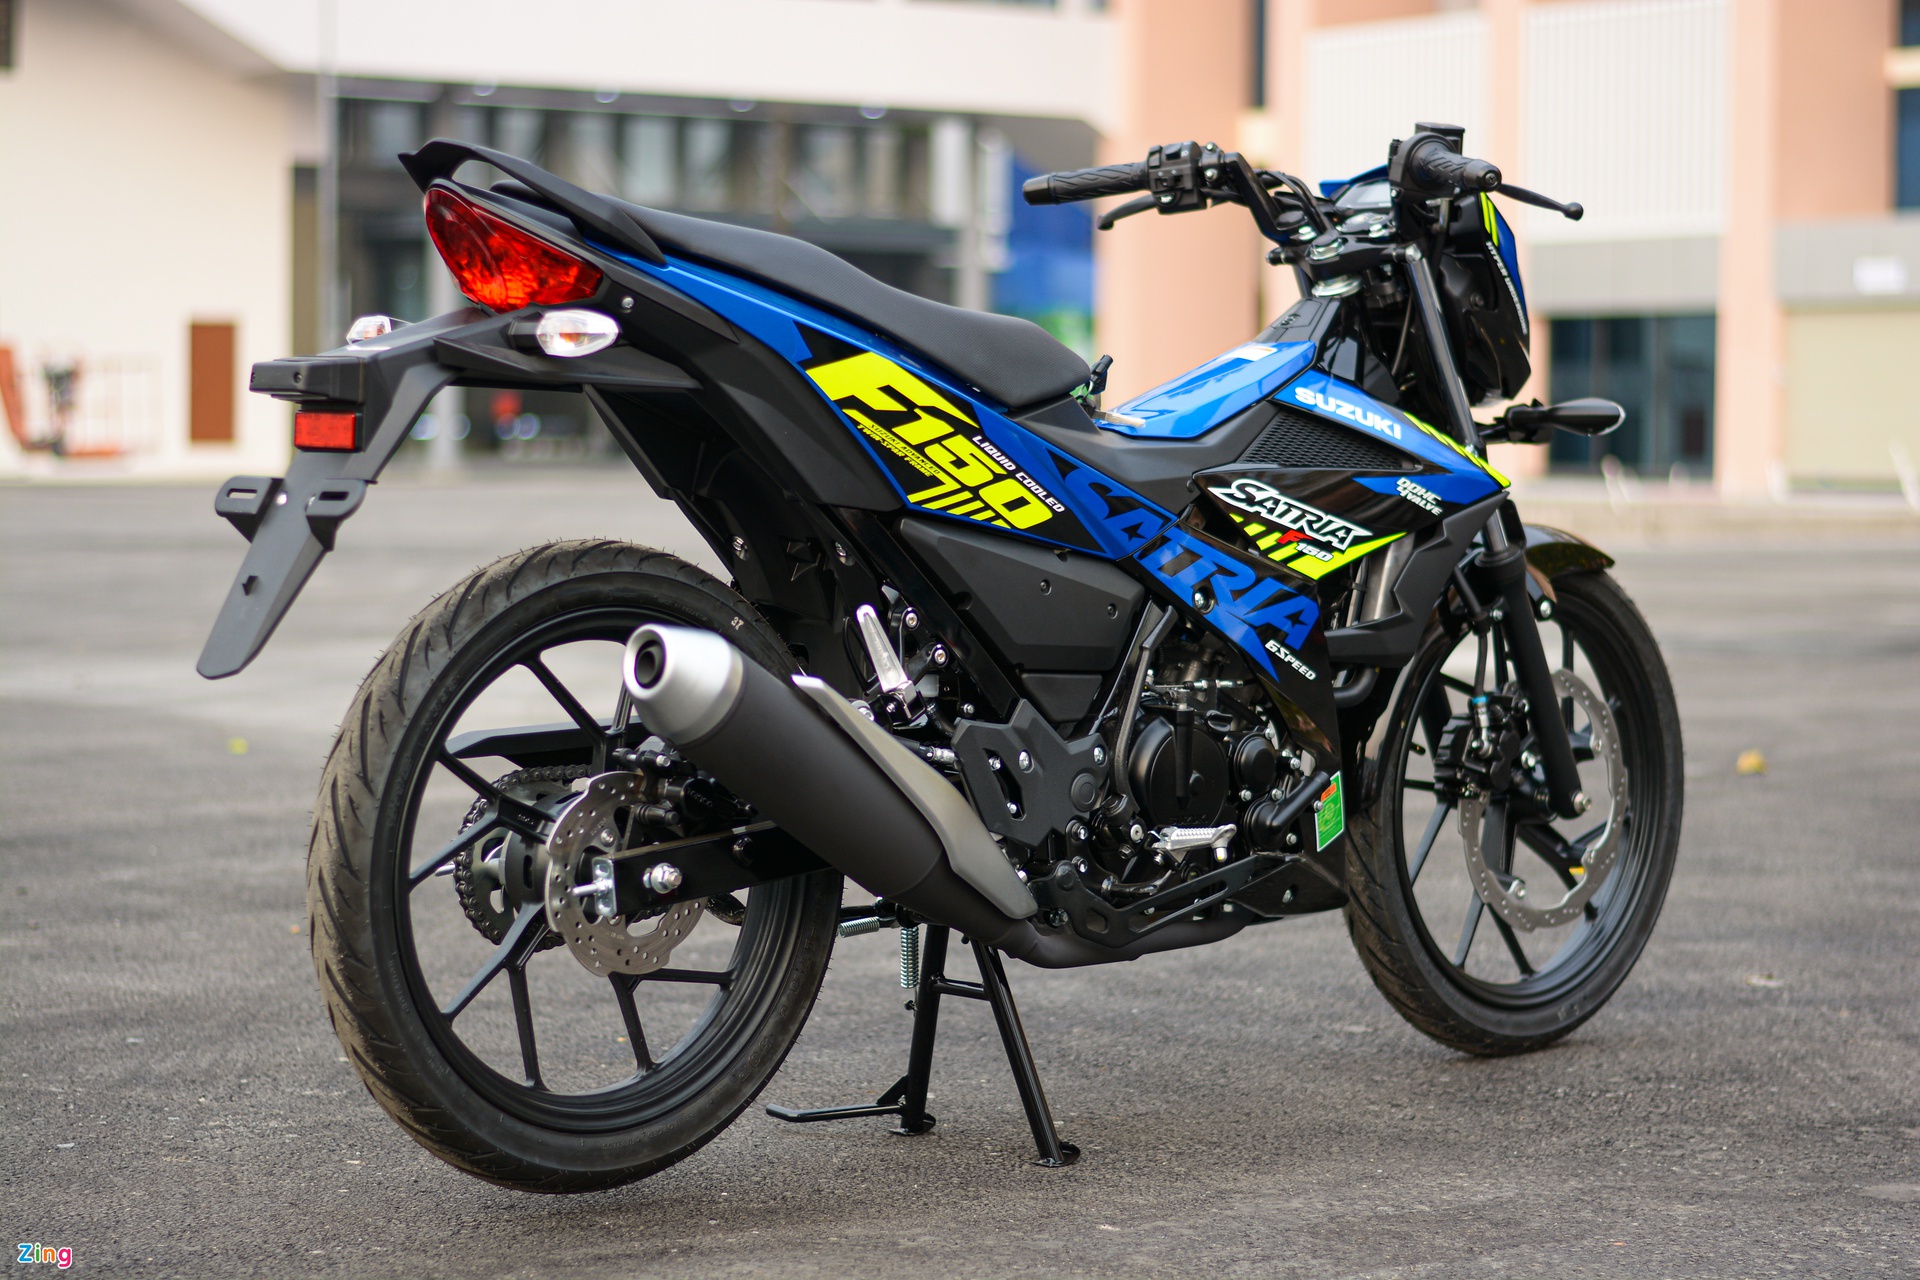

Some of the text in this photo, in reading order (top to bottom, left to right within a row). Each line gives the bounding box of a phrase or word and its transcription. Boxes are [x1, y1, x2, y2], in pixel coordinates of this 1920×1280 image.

[1486, 241, 1508, 277] HYPER
[1295, 386, 1402, 440] SUZUKI
[903, 456, 934, 477] FRAME
[972, 435, 1066, 514] LIQUID COOLED
[1396, 477, 1442, 505] DOHC
[1396, 485, 1443, 516] 4VALVE
[1207, 478, 1374, 551] SATRIA
[1063, 467, 1320, 683] SATRIA
[1264, 639, 1317, 681] 6SPEED
